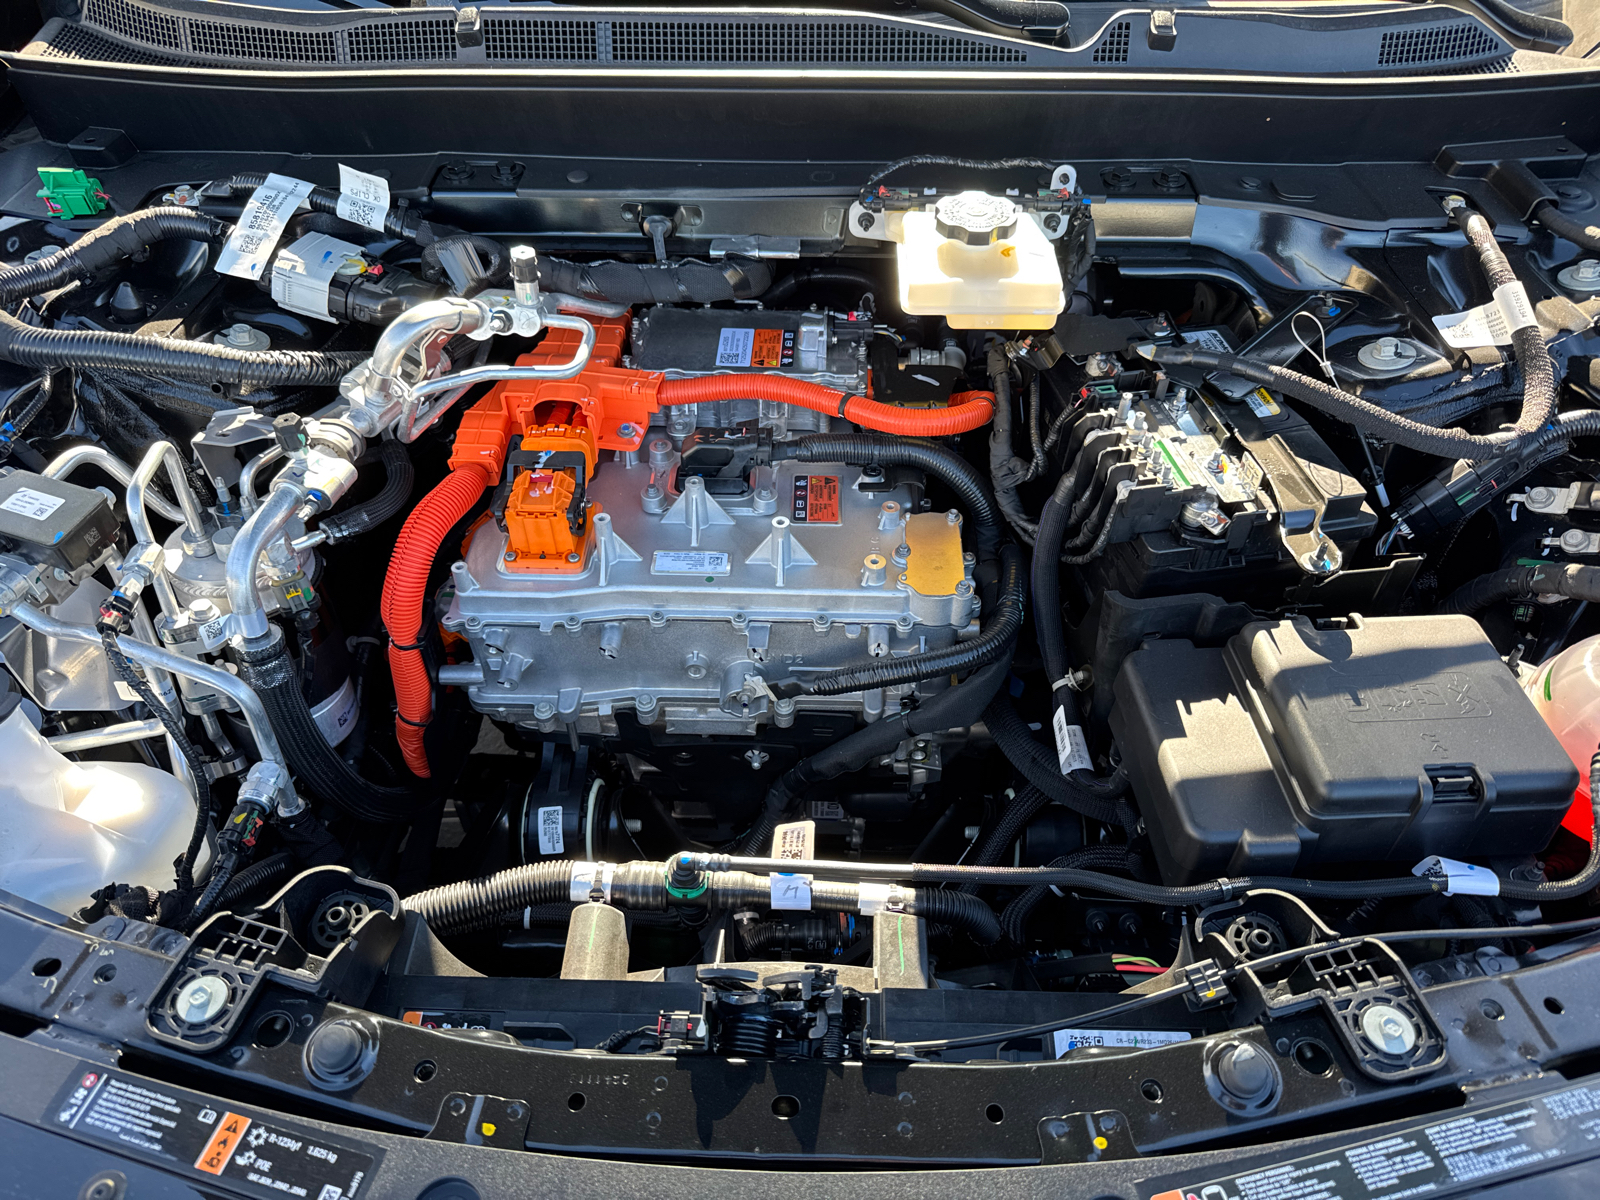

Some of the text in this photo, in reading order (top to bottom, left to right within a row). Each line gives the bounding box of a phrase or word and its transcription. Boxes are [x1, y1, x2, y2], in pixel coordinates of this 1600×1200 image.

[350, 188, 381, 203] OK CLIPS
[248, 194, 273, 231] 85819416
[267, 1132, 338, 1164] R-1234yf 1.625 kg
[253, 1157, 273, 1172] POE
